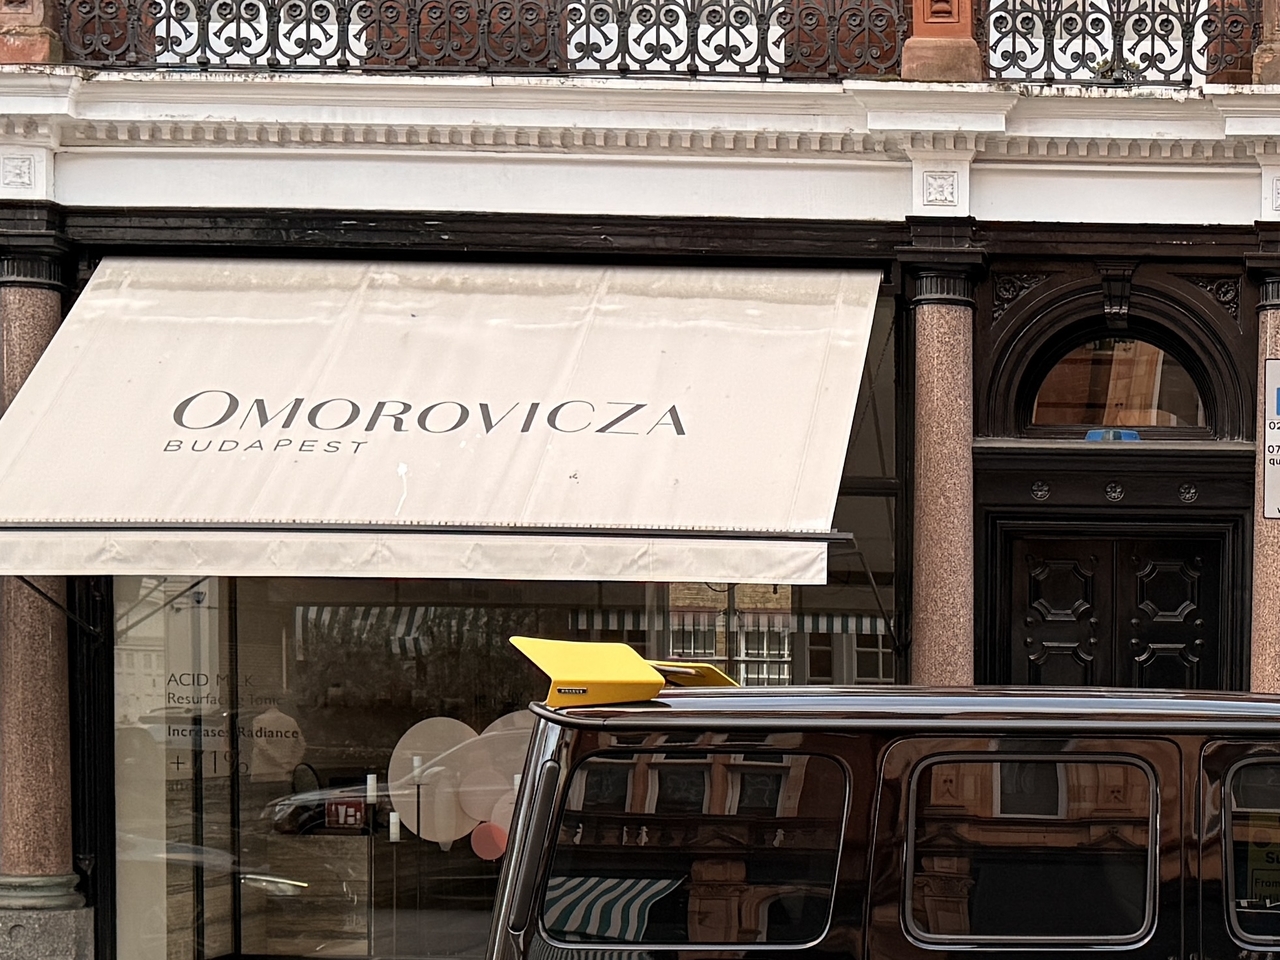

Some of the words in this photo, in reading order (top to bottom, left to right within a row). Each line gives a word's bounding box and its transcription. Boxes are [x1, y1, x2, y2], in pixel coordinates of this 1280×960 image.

[172, 389, 686, 437] OMOROVICZA
[163, 439, 369, 456] BUDAPEST
[167, 672, 209, 687] ACID
[168, 725, 231, 738] Incrase
[237, 726, 300, 739] Radiance
